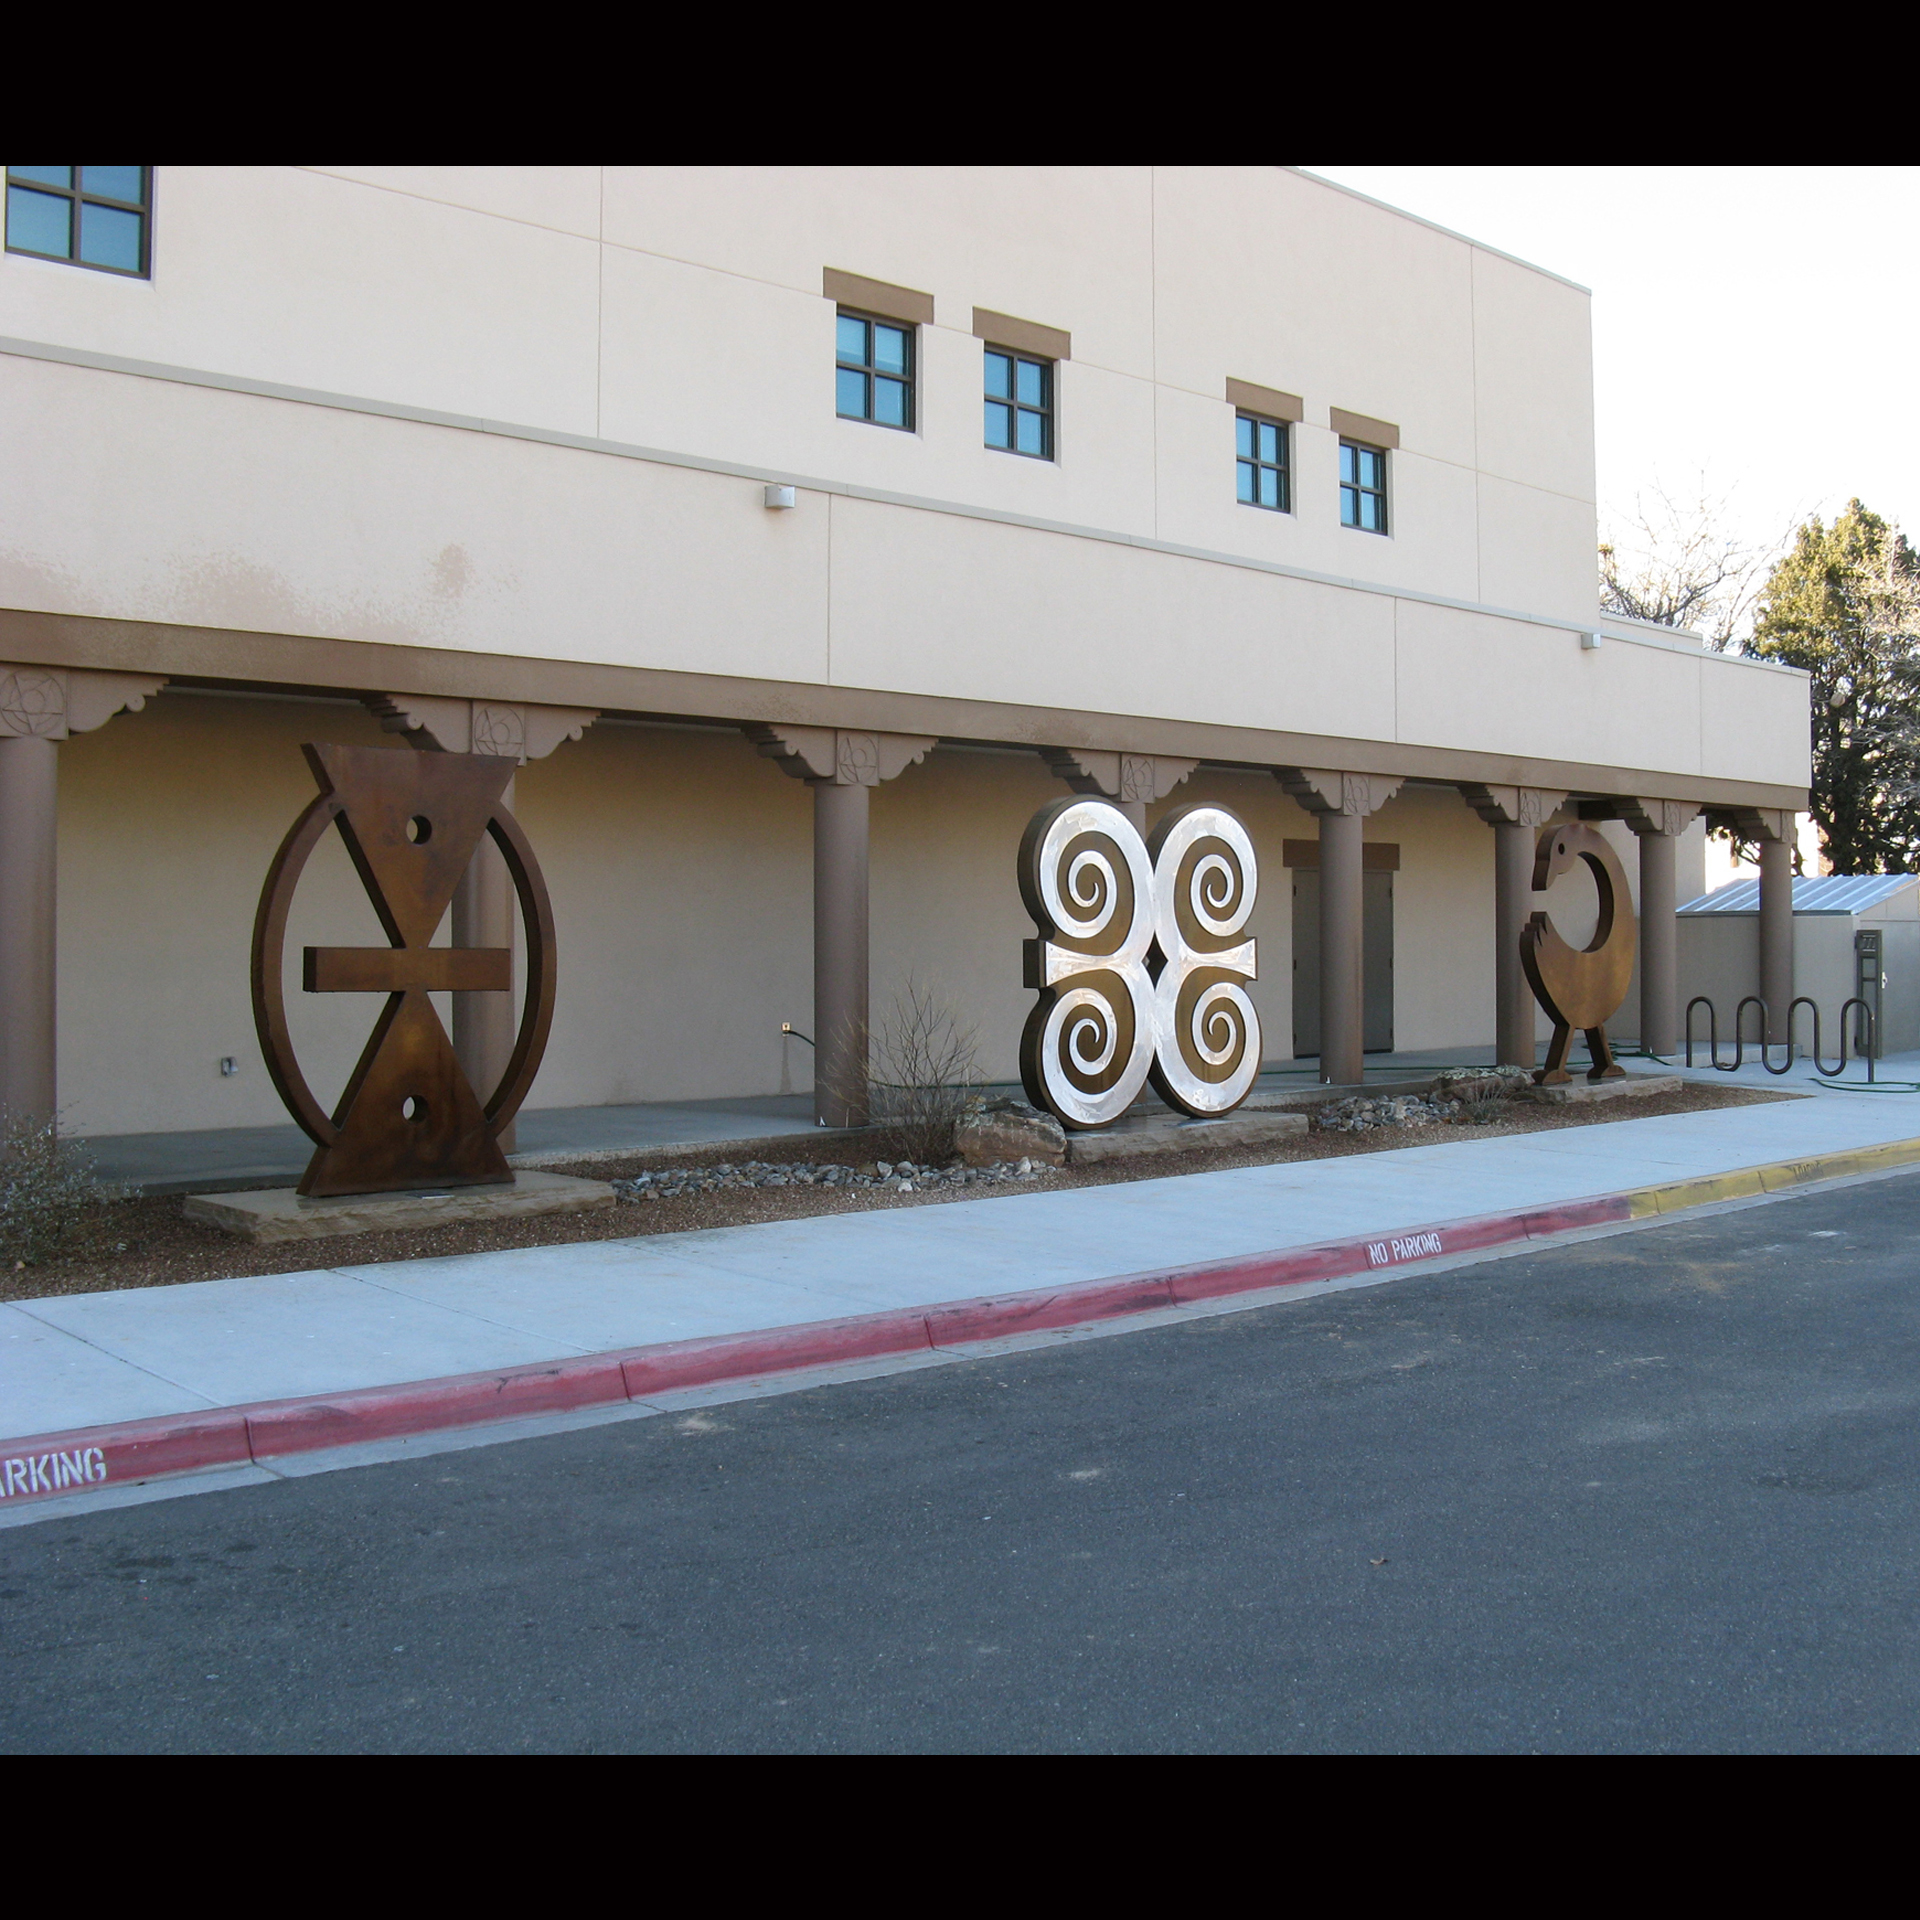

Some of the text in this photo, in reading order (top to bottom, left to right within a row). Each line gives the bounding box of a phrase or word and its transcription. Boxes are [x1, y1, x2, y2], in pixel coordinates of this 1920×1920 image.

[1368, 1232, 1442, 1265] NO PARKING
[0, 1447, 107, 1498] RKING
